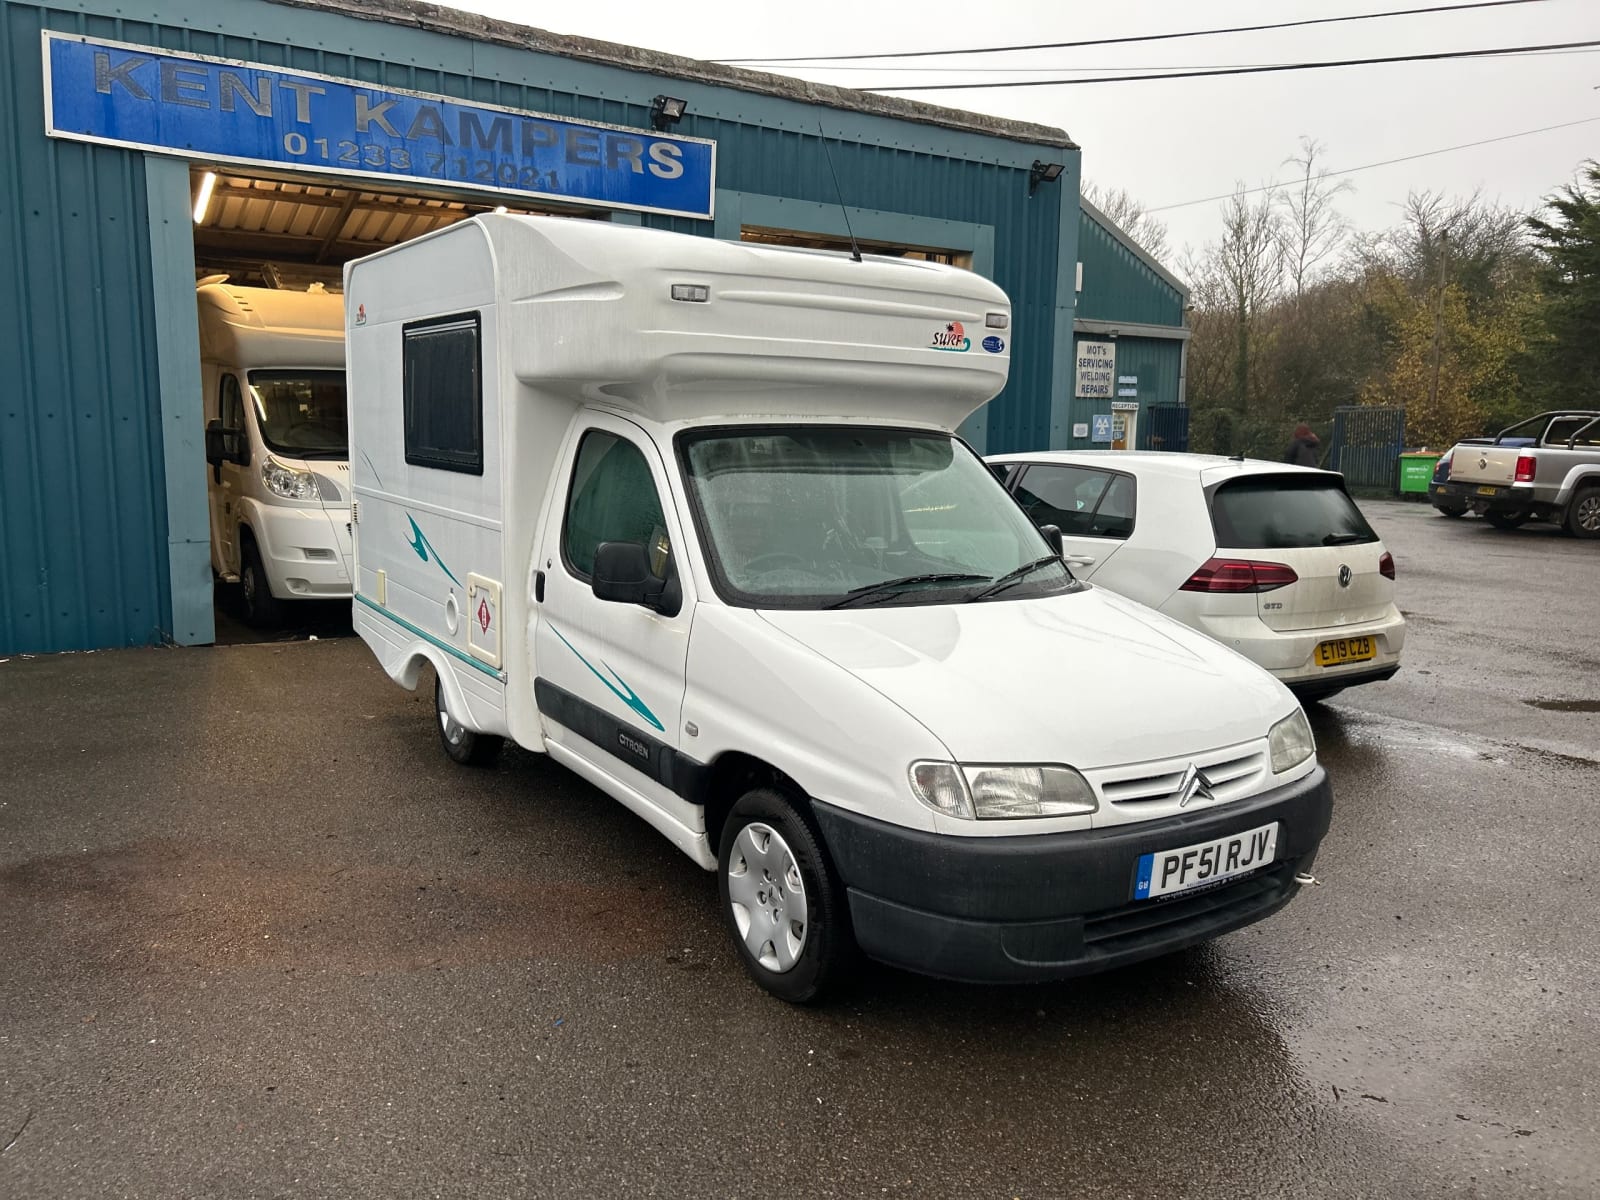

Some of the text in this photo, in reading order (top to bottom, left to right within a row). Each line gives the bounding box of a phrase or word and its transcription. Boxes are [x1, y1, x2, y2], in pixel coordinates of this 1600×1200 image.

[94, 51, 685, 180] KENT KAMPERS
[283, 132, 559, 190] 01233 712021
[932, 331, 963, 347] SURF
[1086, 345, 1107, 356] MOT's
[1078, 358, 1113, 369] SERVICING
[1080, 371, 1110, 382] WELDING
[1081, 384, 1109, 394] REPAIRS
[1263, 602, 1282, 610] GTD
[1320, 638, 1370, 661] ET19 CZB
[1161, 844, 1222, 889] PF51
[1225, 829, 1270, 872] RJV
[1137, 880, 1149, 890] GB
